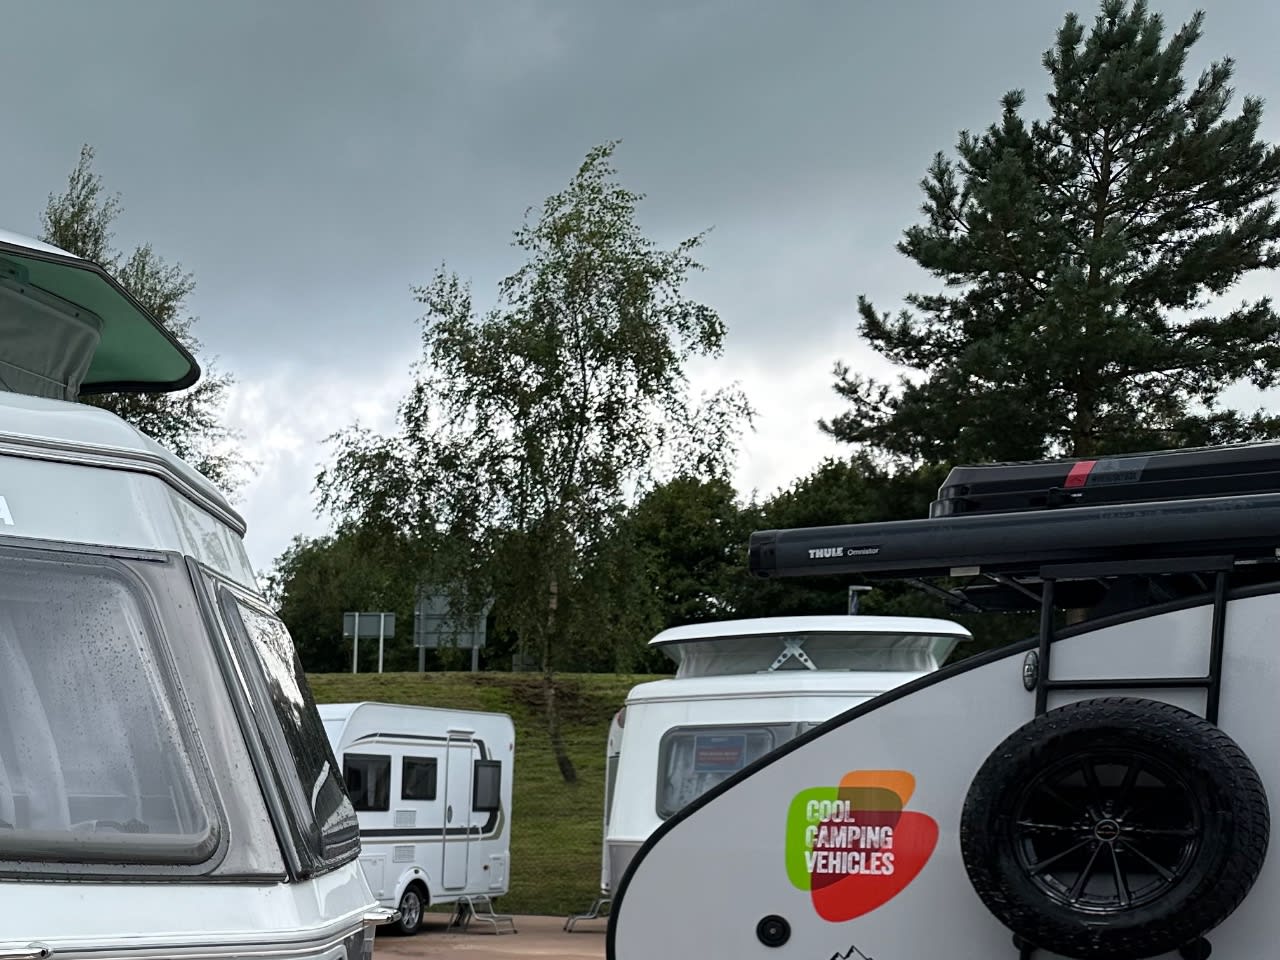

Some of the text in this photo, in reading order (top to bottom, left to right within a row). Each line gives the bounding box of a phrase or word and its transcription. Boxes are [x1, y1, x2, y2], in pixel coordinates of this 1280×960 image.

[808, 547, 844, 559] THULE
[806, 799, 856, 823] COOL
[805, 825, 894, 849] CAMPING
[805, 850, 895, 876] VEHICLES
